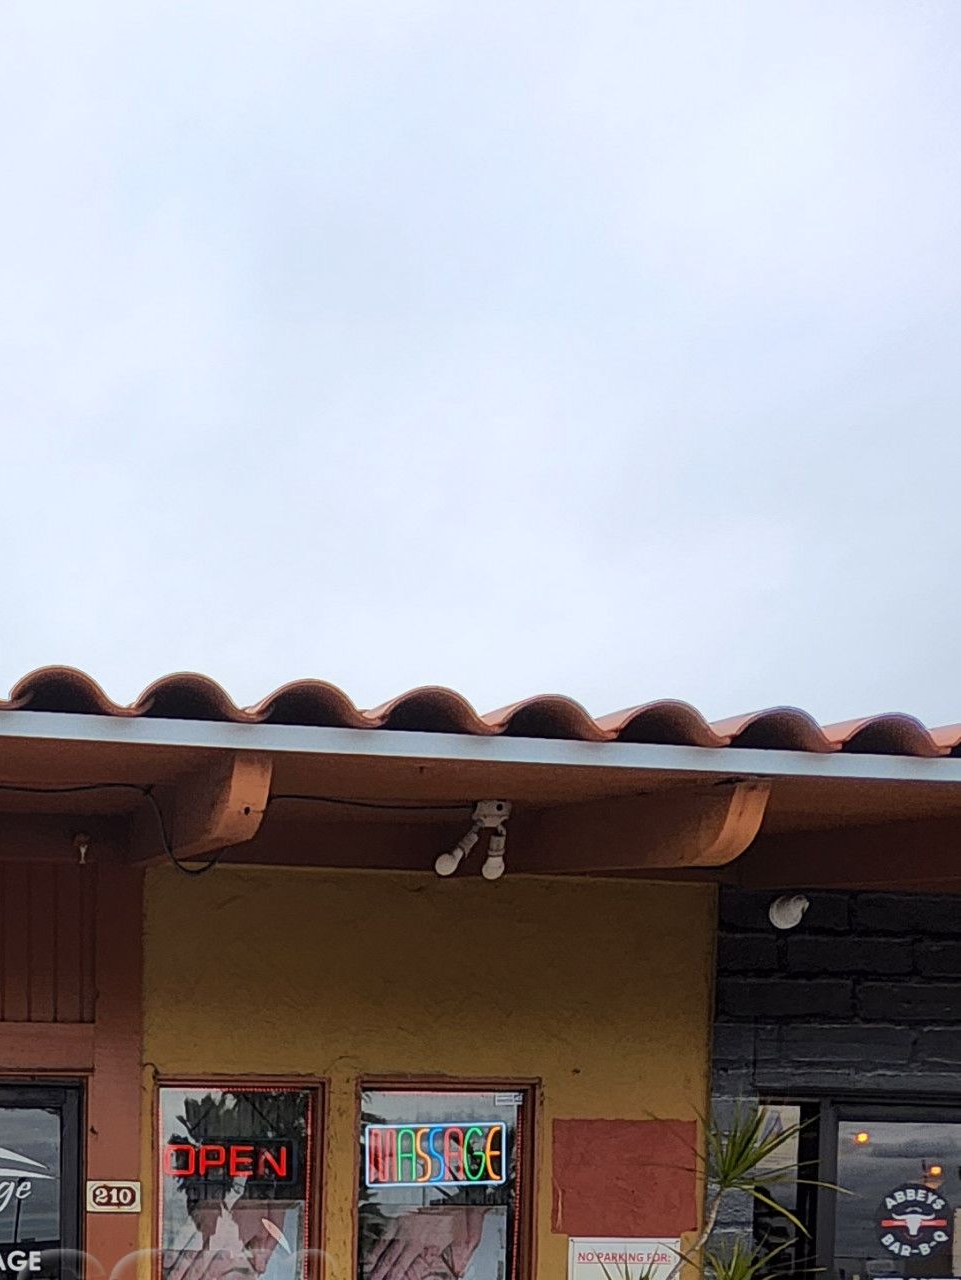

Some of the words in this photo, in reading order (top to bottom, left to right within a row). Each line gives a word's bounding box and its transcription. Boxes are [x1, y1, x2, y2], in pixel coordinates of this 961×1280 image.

[164, 1144, 288, 1178] OPEN
[369, 1126, 501, 1183] MASSAGE
[94, 1187, 133, 1204] 210
[885, 1188, 946, 1210] ABBEYS
[880, 1230, 950, 1257] BAR-B-Q
[577, 1252, 594, 1263] NO
[598, 1252, 644, 1263] PARKING
[646, 1253, 672, 1263] FOR:
